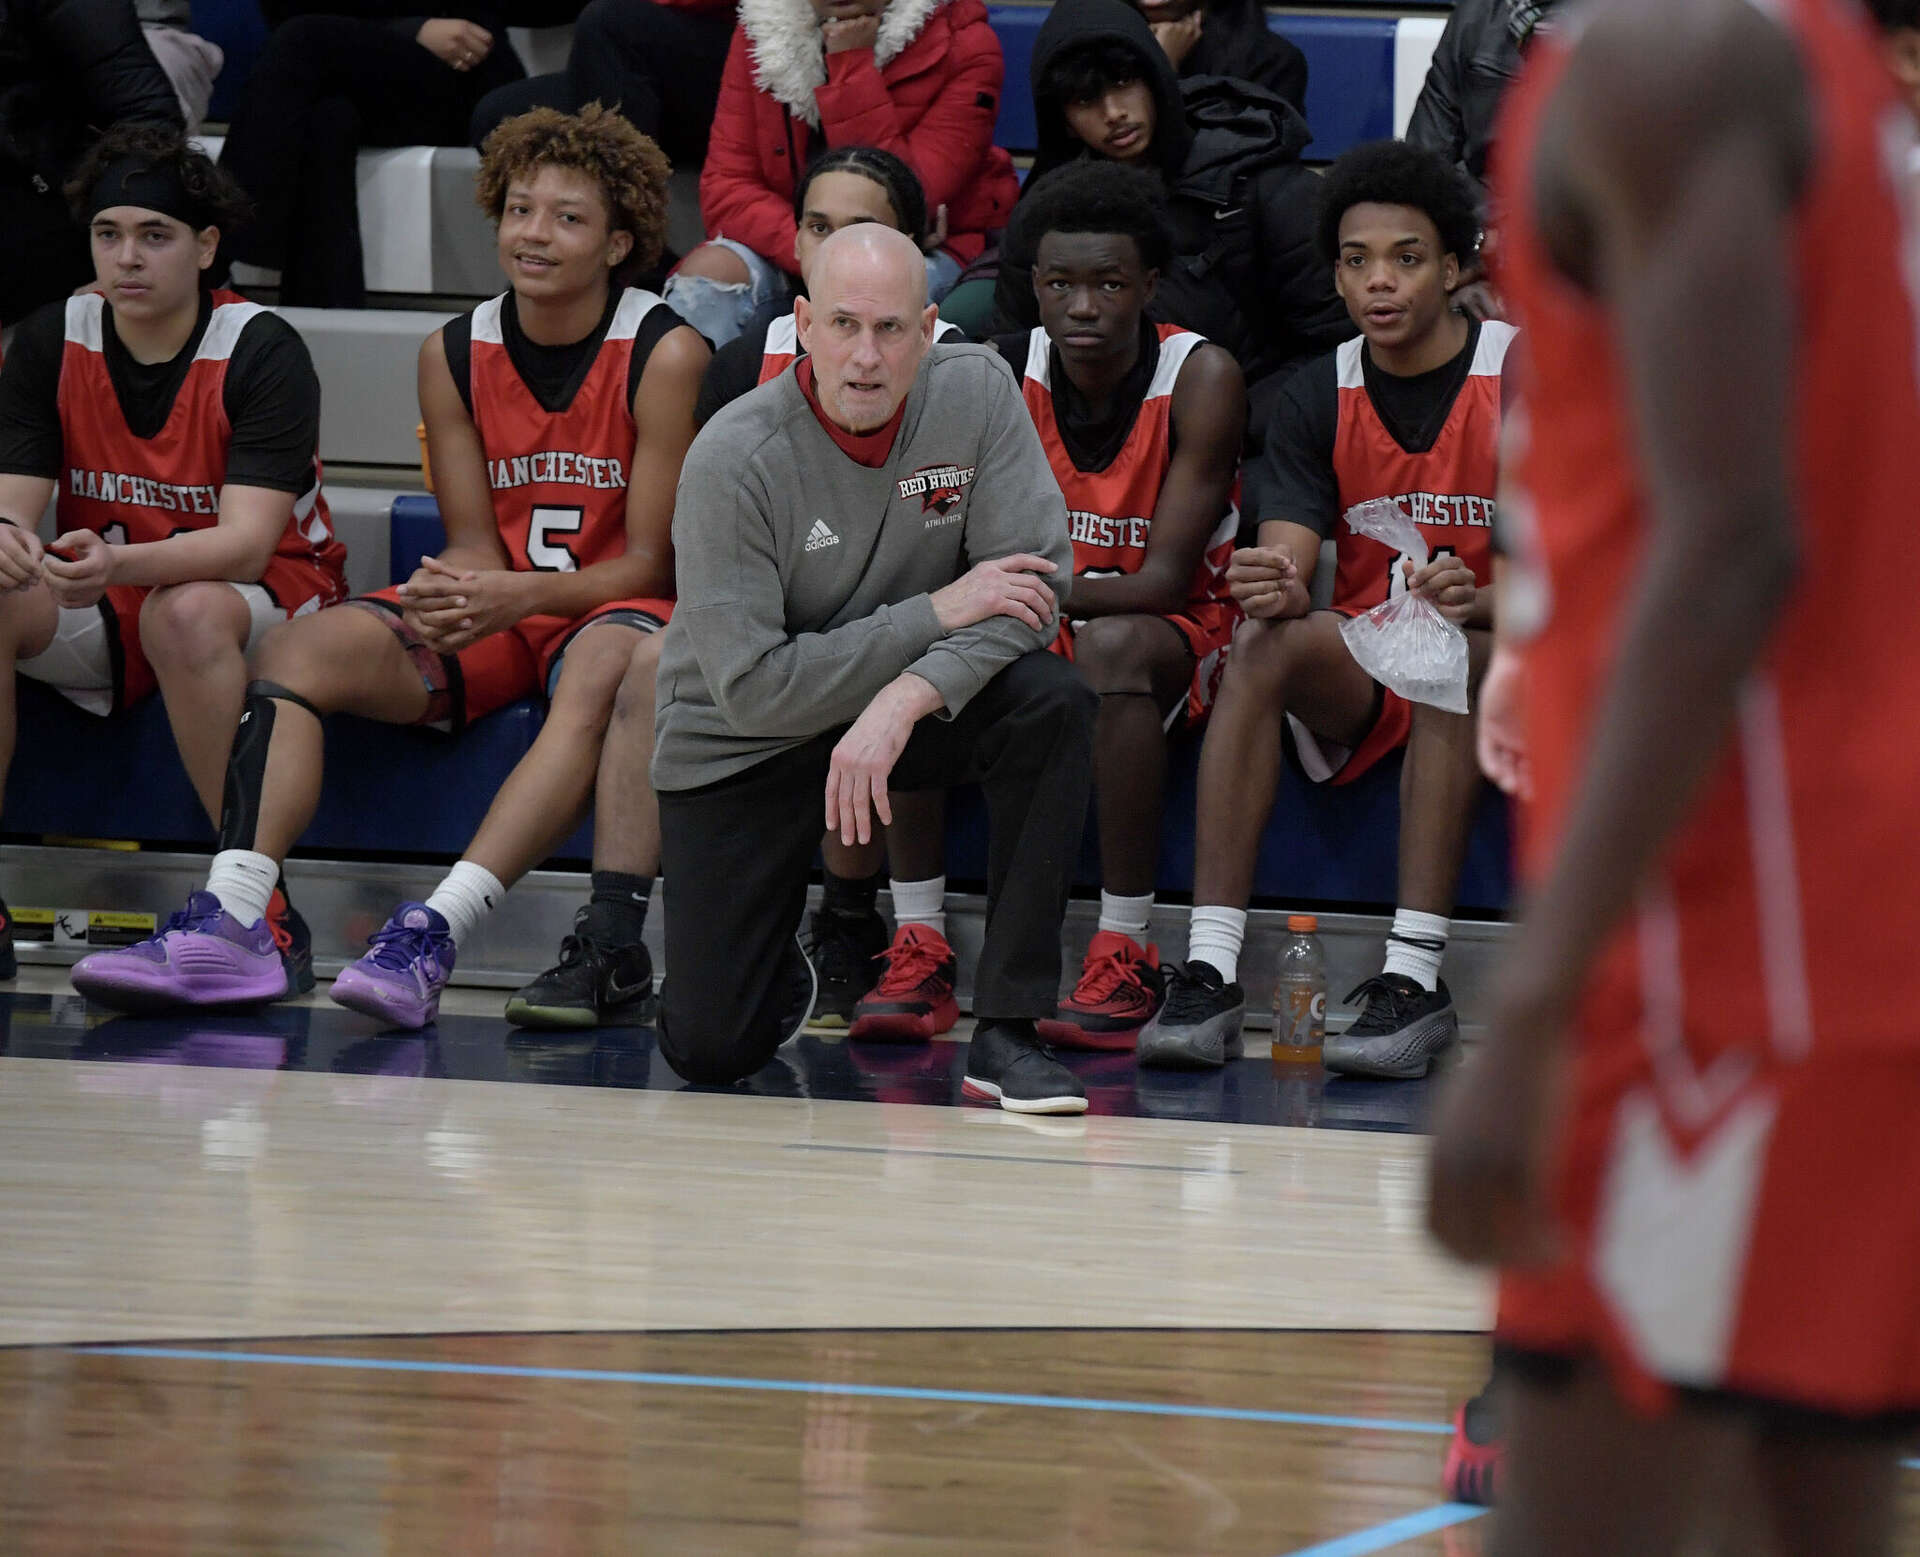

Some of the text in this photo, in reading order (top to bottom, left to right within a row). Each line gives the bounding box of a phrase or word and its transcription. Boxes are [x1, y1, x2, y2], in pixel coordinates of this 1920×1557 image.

[898, 476, 927, 499] RED
[928, 467, 975, 490] HAWKS
[527, 506, 582, 572] 5
[804, 534, 840, 552] adidas
[1067, 510, 1151, 548] HESTE
